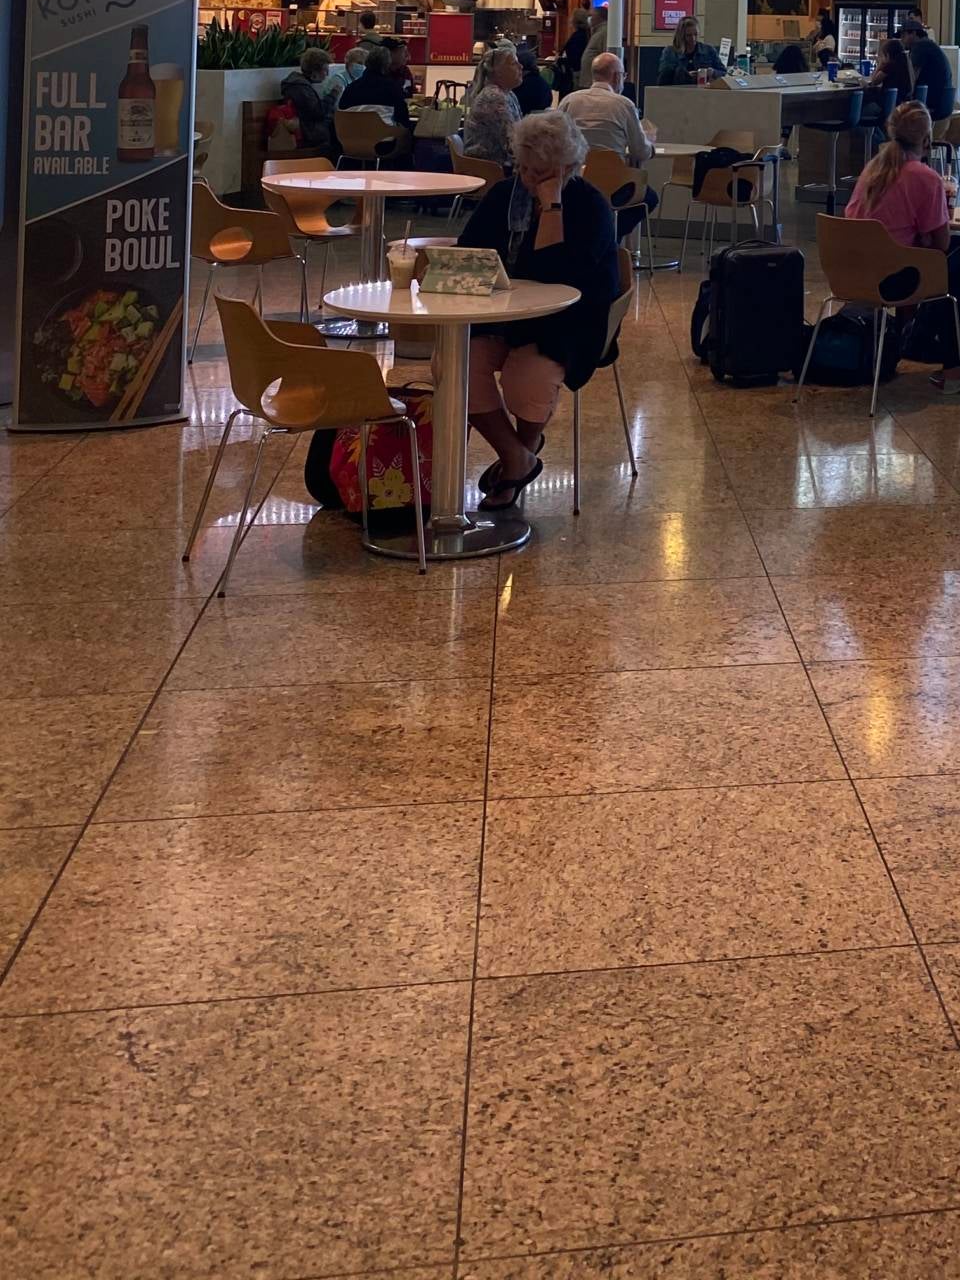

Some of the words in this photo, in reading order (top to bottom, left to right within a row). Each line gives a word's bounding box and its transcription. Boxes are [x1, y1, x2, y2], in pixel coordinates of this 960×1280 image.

[60, 9, 96, 27] SUSHI
[36, 71, 106, 109] FULL
[34, 114, 91, 151] BAR
[33, 157, 109, 175] AVAILABLE
[106, 198, 170, 233] POKE
[104, 235, 180, 272] BOWL
